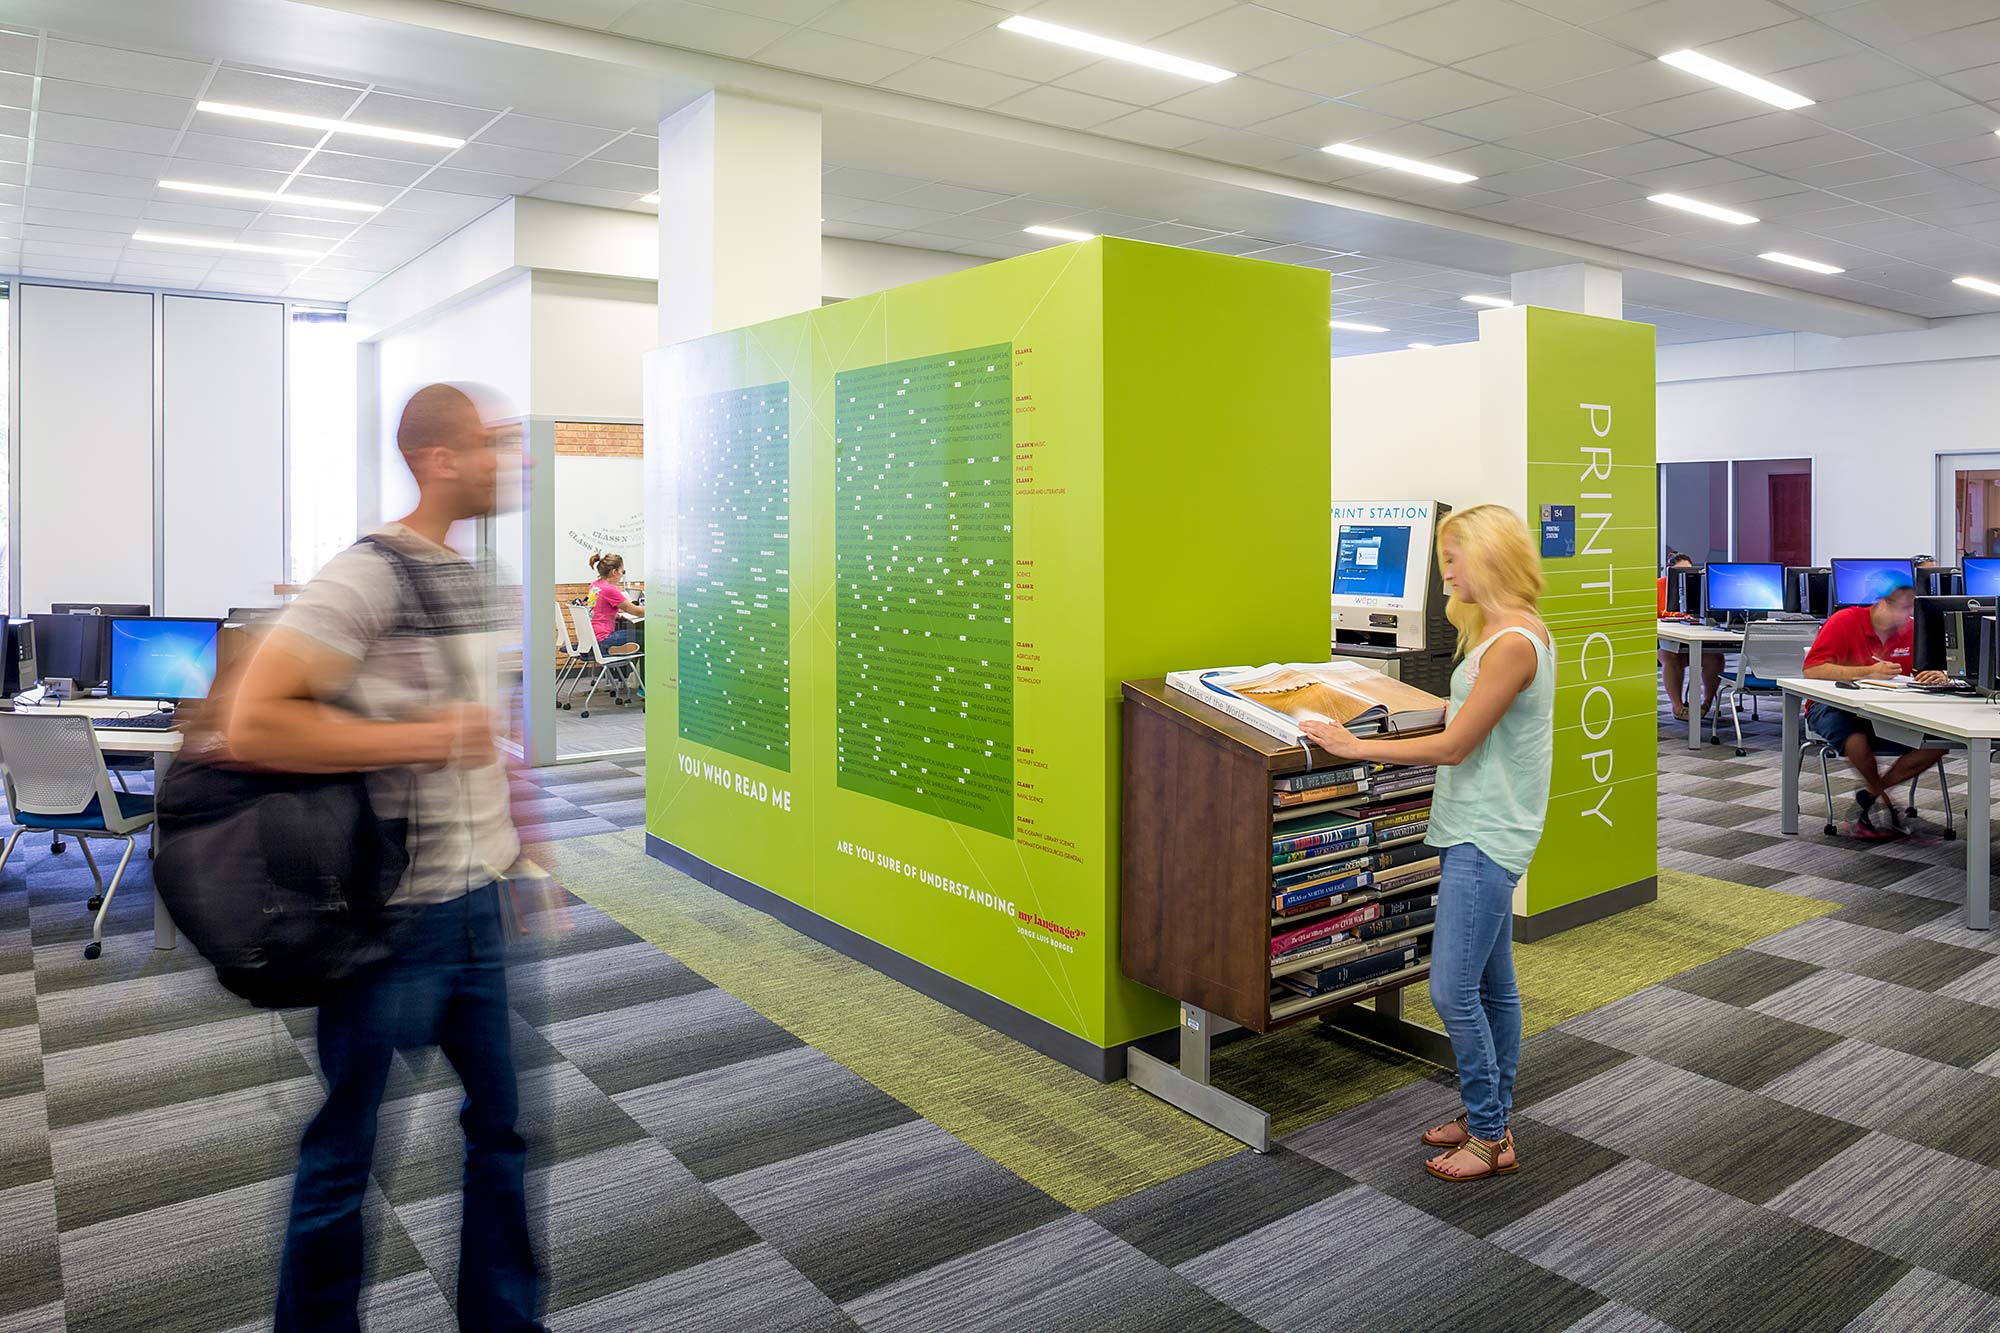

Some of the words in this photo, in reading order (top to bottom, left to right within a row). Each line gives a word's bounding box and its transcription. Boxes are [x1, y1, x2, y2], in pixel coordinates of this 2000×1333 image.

[1369, 507, 1428, 518] STATION
[1580, 403, 1613, 604] PRINT
[1187, 686, 1204, 700] Atlas
[1212, 698, 1224, 709] the
[1224, 703, 1245, 720] World
[1581, 632, 1613, 826] COPY
[678, 753, 700, 778] YOU
[704, 762, 732, 789] WHO
[736, 774, 768, 802] READ
[773, 788, 791, 811] ME
[1392, 826, 1416, 837] WORLD
[837, 841, 853, 855] ARE
[856, 846, 875, 863] YOU
[878, 854, 901, 873] SURE
[904, 864, 917, 879] OF
[920, 870, 1015, 917] UNDERSTANDING
[1018, 911, 1033, 925] my
[1287, 894, 1302, 903] ATLAS
[1308, 888, 1324, 897] NORTH
[1017, 927, 1036, 939] JORGE
[1036, 933, 1049, 944] LUIS
[1050, 938, 1074, 954] BORGES
